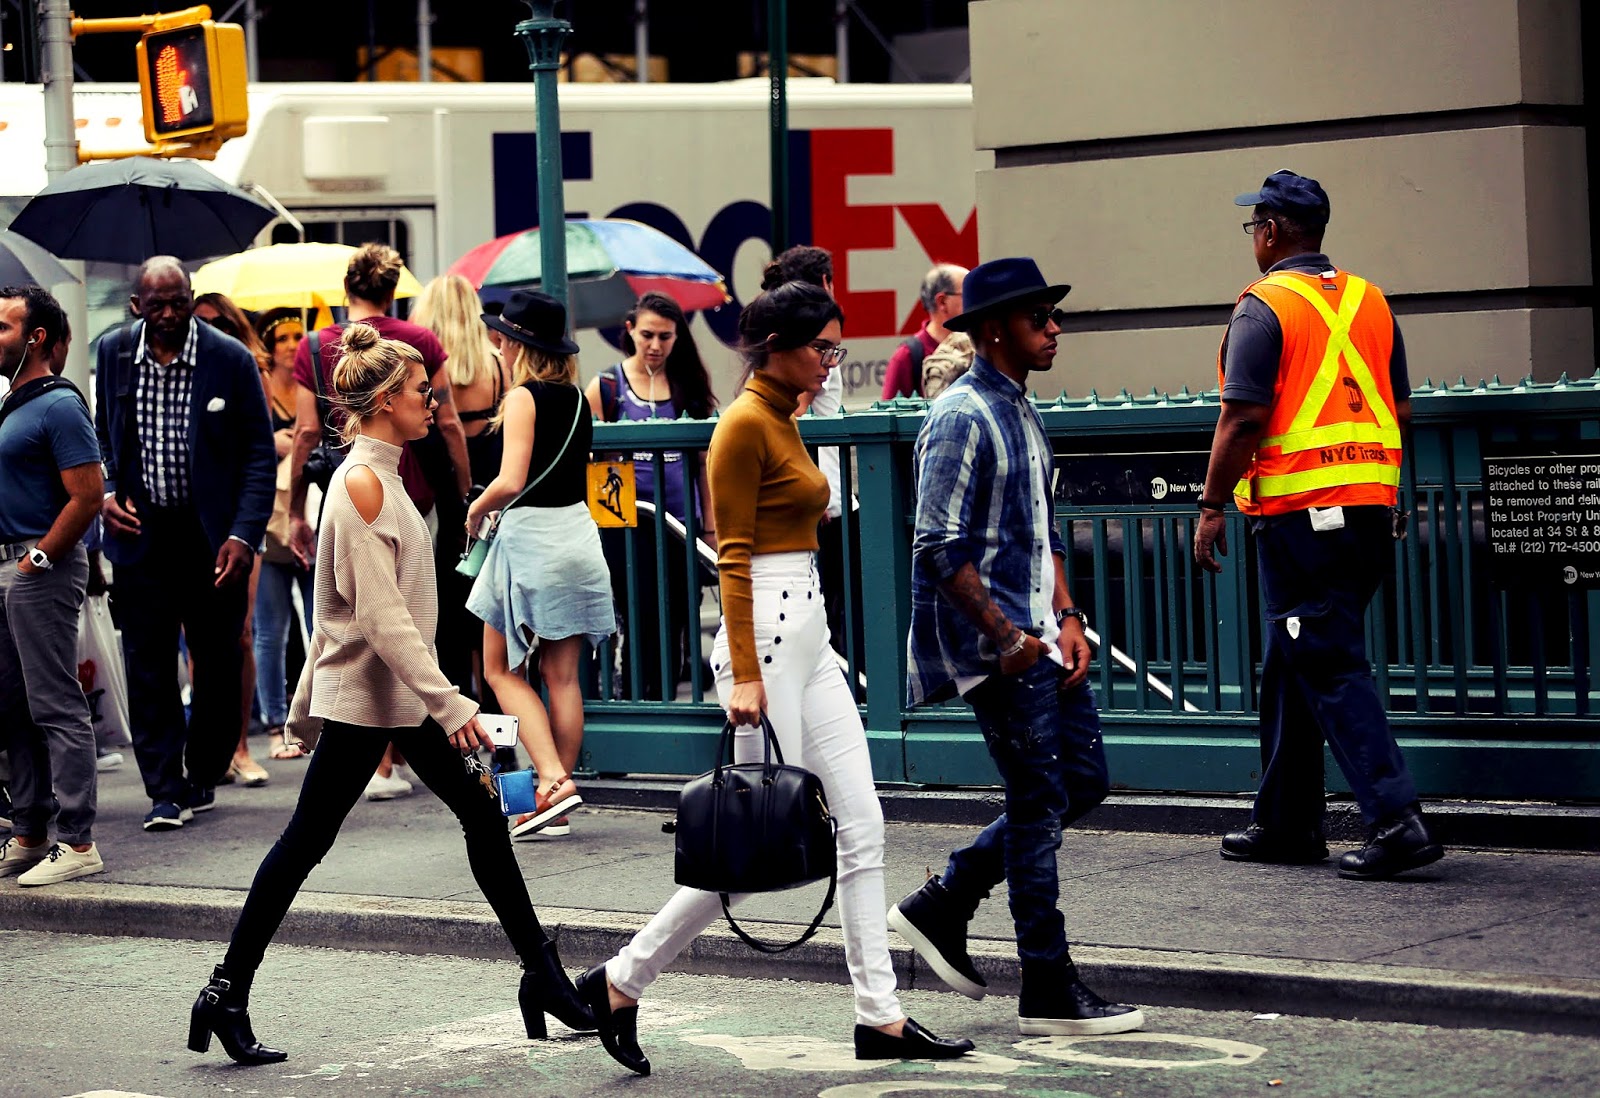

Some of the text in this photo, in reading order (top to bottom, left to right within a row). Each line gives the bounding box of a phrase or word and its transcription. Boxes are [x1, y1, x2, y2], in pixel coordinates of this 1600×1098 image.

[1320, 446, 1356, 464] NYC
[1488, 464, 1531, 478] Bicycles
[1534, 466, 1545, 475] or
[1549, 463, 1577, 475] other
[1170, 484, 1187, 493] New
[1489, 479, 1535, 491] attached
[1538, 480, 1549, 490] to
[1553, 479, 1582, 490] these
[1489, 495, 1503, 506] be
[1506, 495, 1551, 506] removed
[1555, 494, 1575, 506] and
[1491, 511, 1508, 522] the
[1510, 511, 1534, 522] Lost
[1537, 510, 1582, 523] Property
[1491, 526, 1530, 538] located
[1532, 526, 1544, 537] at
[1547, 525, 1562, 537] 34
[1565, 525, 1578, 537] St
[1581, 525, 1590, 537] &
[1492, 540, 1600, 554] Tel.# (212) 712-4500
